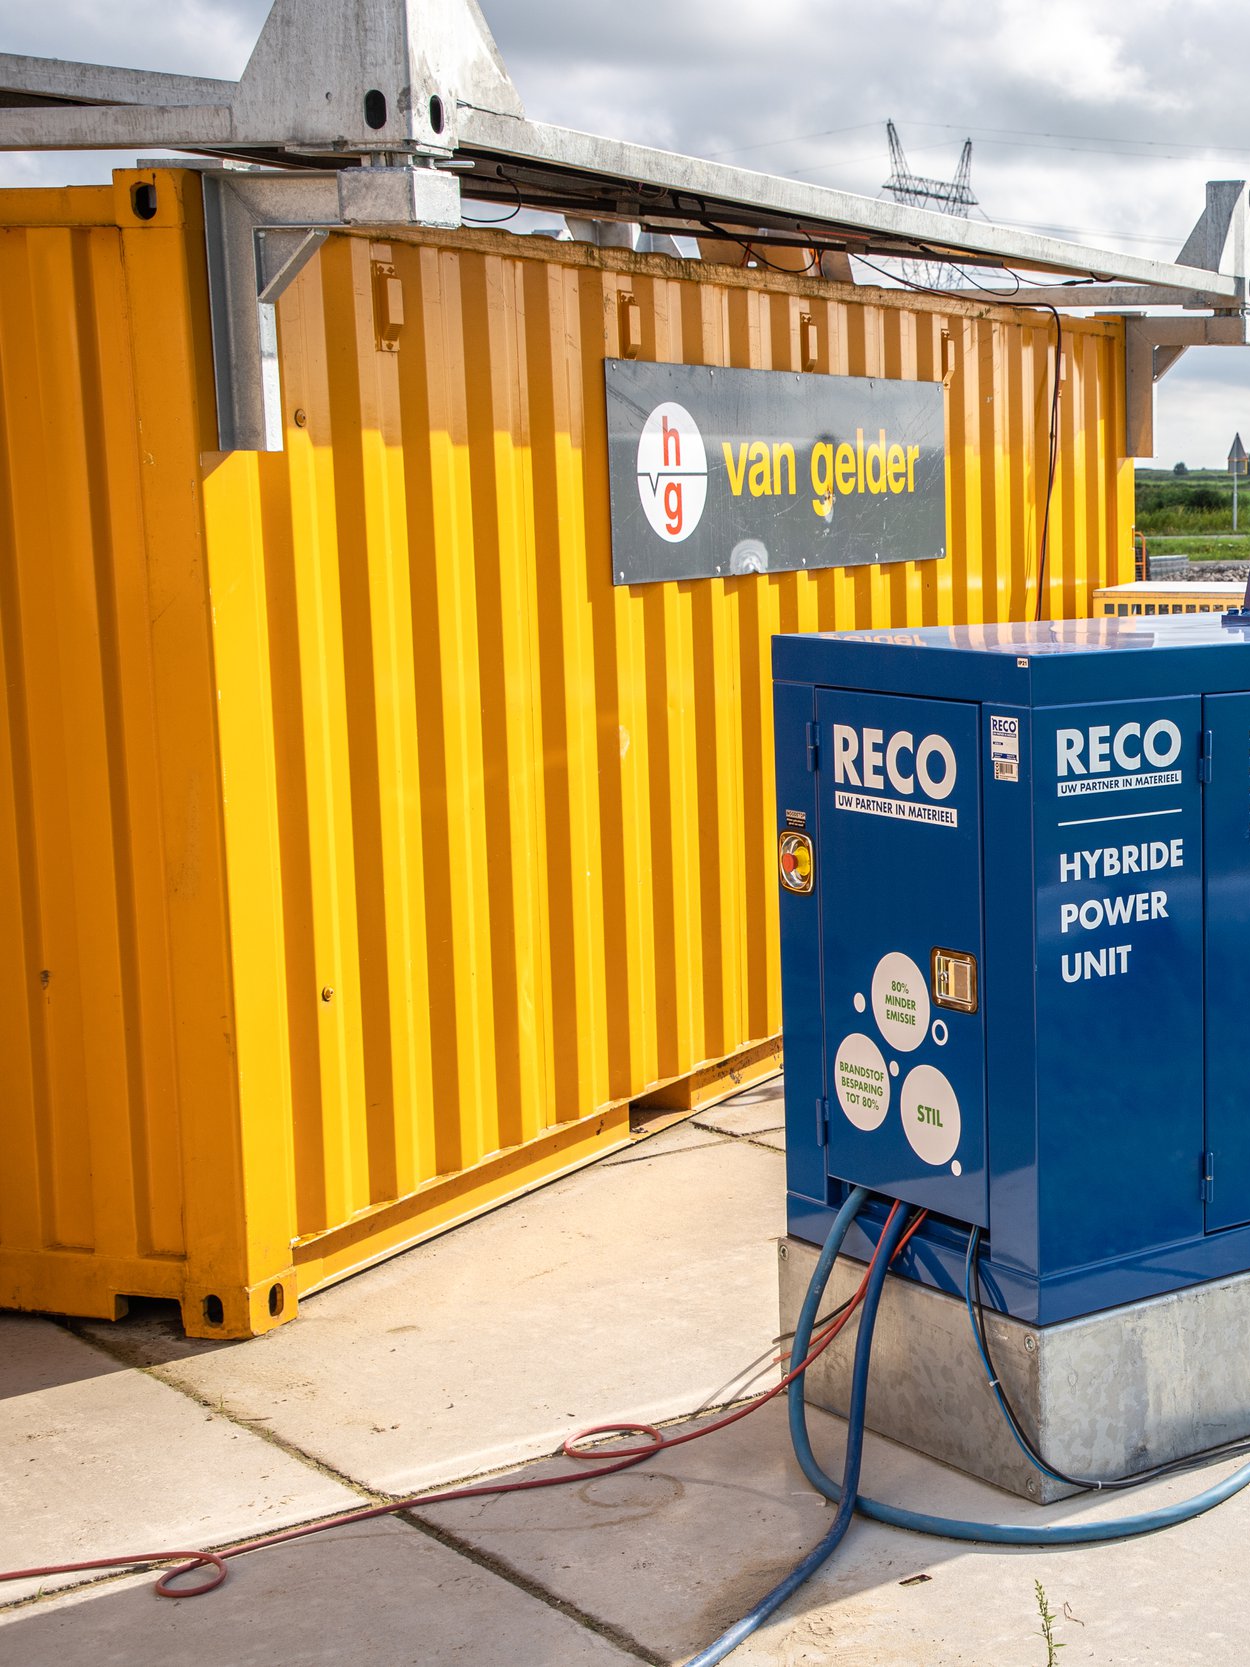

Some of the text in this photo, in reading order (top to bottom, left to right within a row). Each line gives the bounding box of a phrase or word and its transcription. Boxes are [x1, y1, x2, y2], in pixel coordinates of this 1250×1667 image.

[662, 415, 681, 467] h
[721, 427, 920, 517] van gelder
[992, 719, 1017, 733] RECO
[1056, 718, 1182, 777] RECO
[833, 723, 957, 800] RECO
[1060, 773, 1180, 794] UW PARTNER IN MATERIEEL
[838, 794, 955, 824] UW PARTNER IN MATERIEEL
[1059, 838, 1184, 883] HYBRIDE
[1061, 890, 1169, 933] POWER
[1061, 944, 1132, 983] UNIT
[891, 980, 910, 994] 80%
[884, 994, 917, 1012] MINDER
[886, 1009, 916, 1026] EMISSIE
[839, 1061, 885, 1083] BRANDSTOF
[841, 1077, 884, 1097] BESPARING
[845, 1091, 880, 1111] TOT 80%
[916, 1104, 944, 1128] STIL
